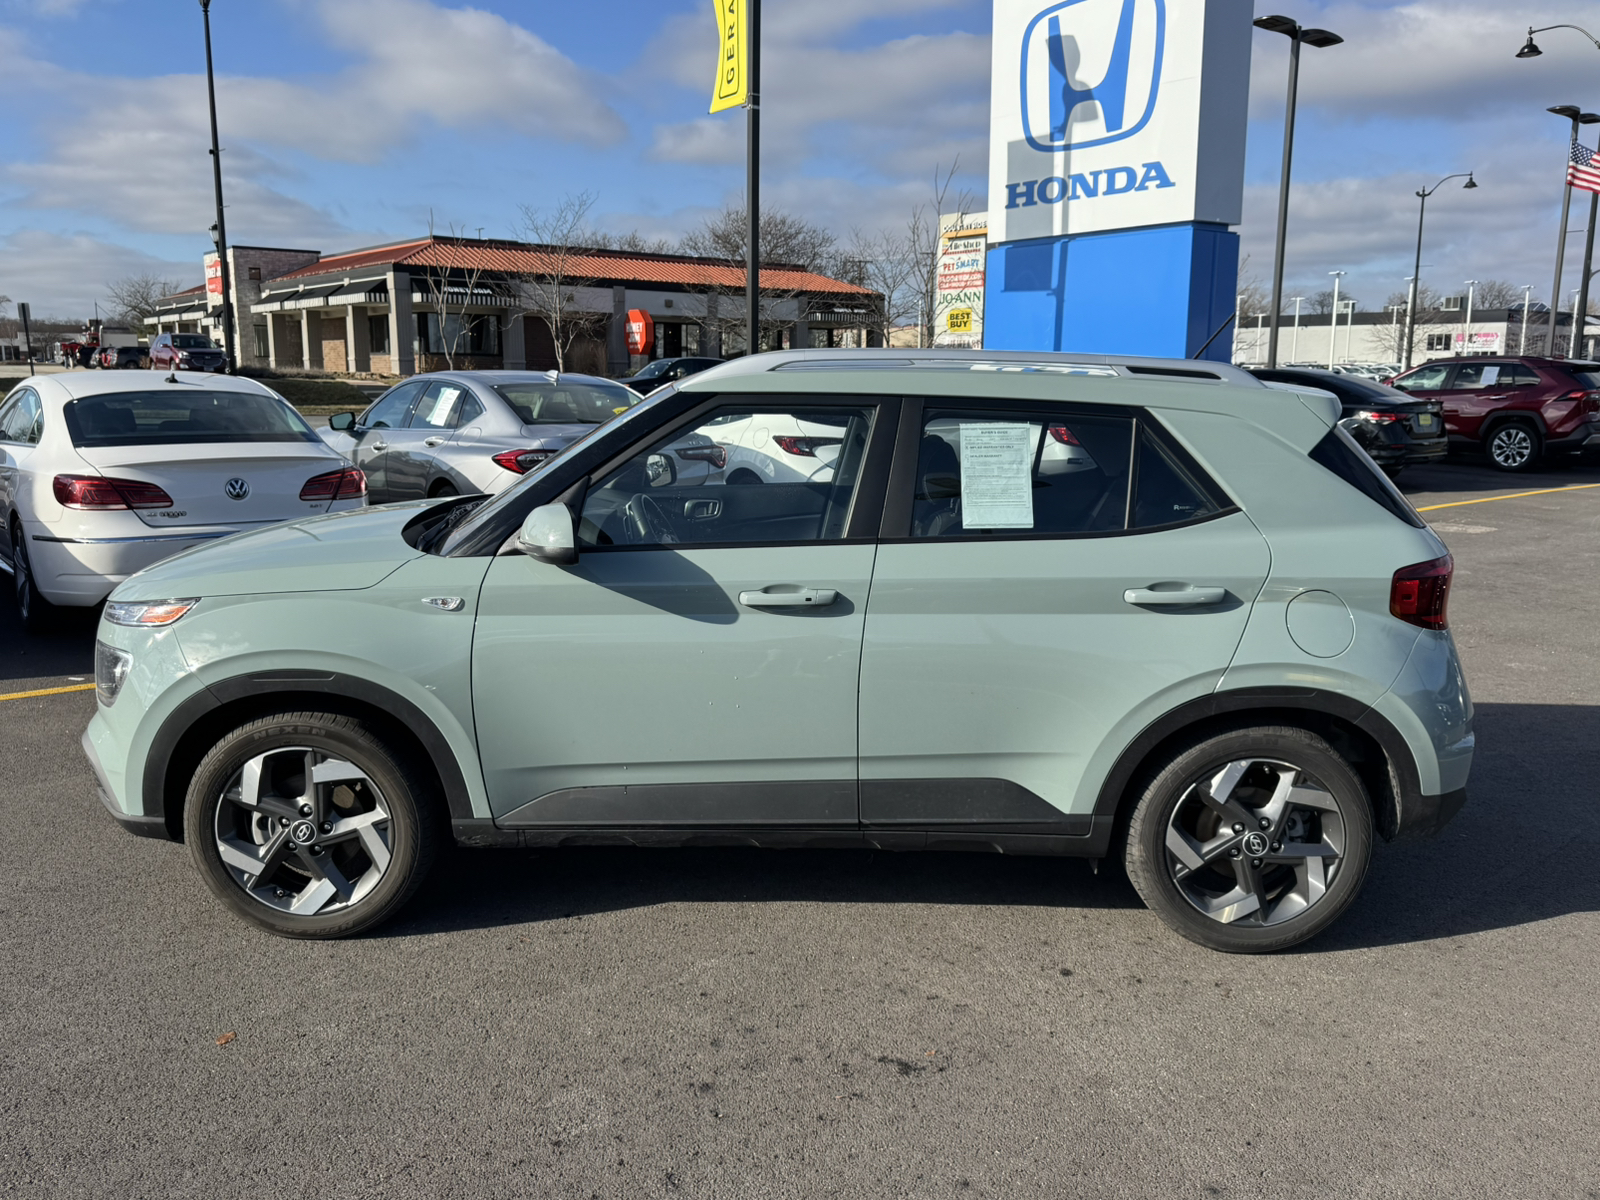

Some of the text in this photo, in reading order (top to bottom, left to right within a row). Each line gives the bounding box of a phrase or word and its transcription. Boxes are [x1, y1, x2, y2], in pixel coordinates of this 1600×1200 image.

[1005, 161, 1175, 210] HONDA
[950, 312, 971, 320] BEST
[950, 320, 968, 328] BUY
[253, 726, 326, 740] NEXEN
